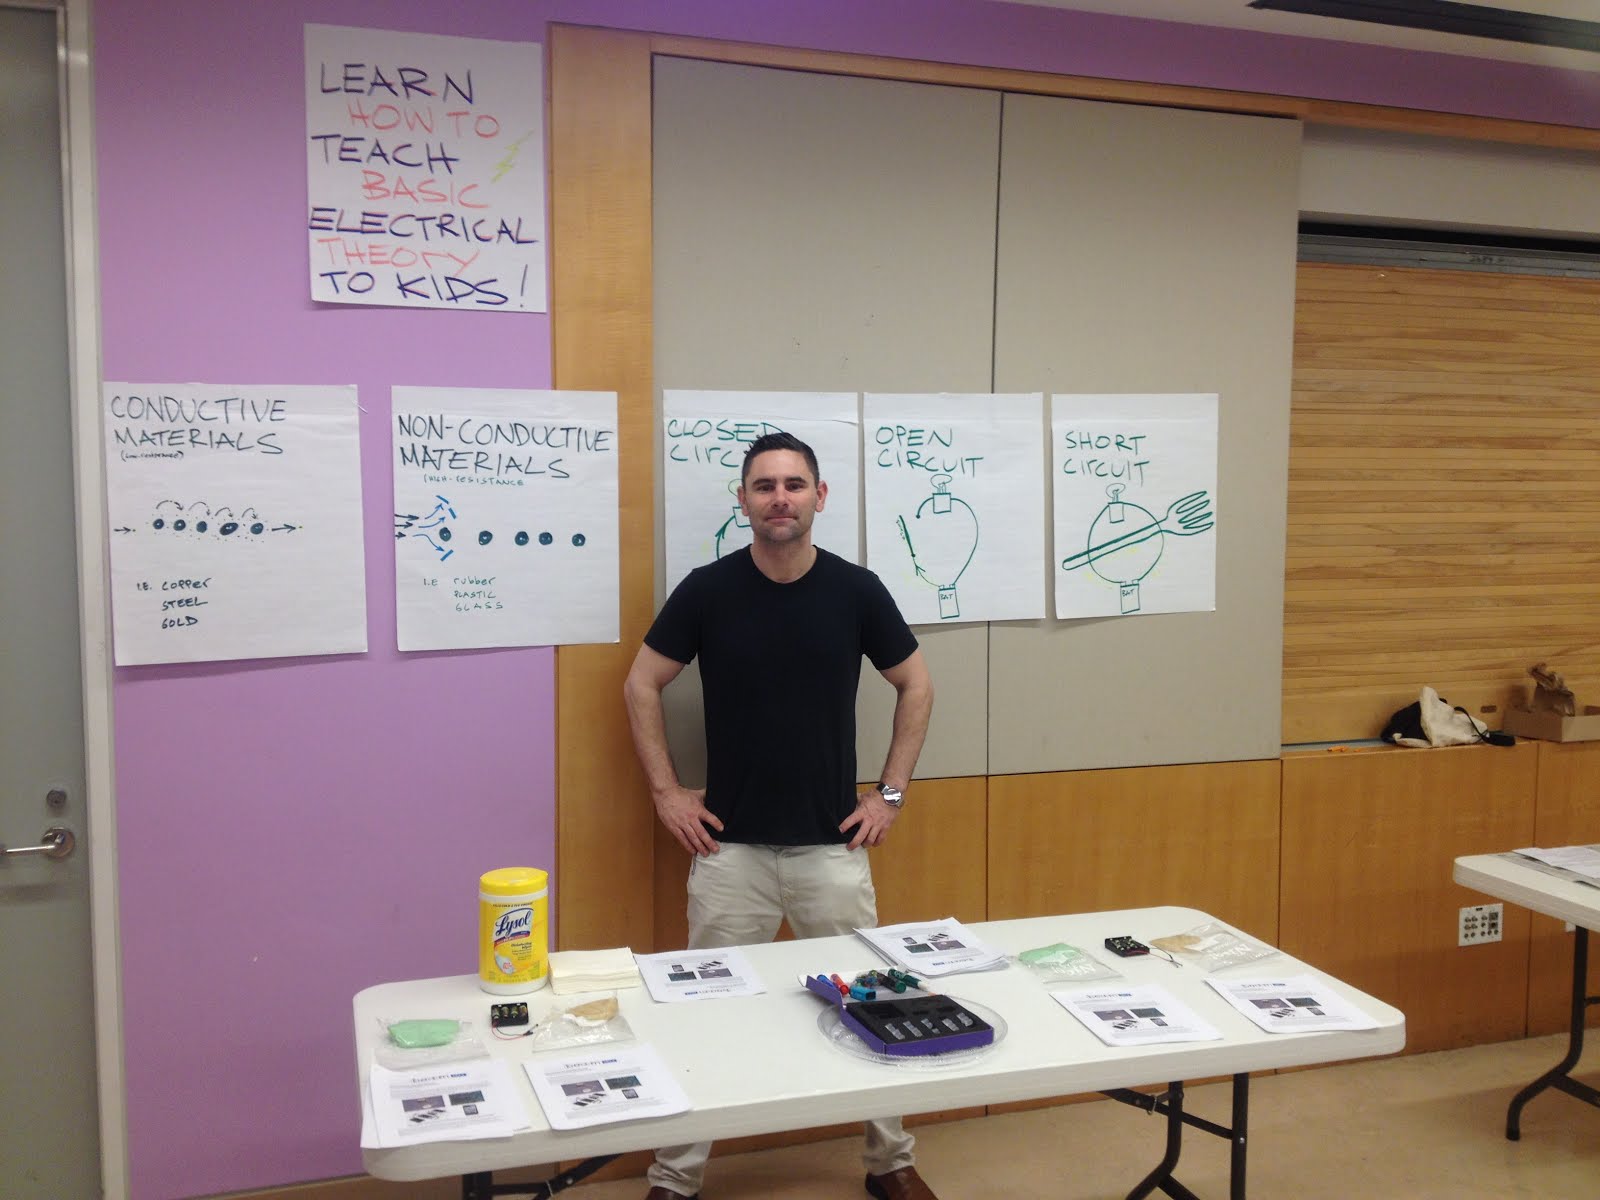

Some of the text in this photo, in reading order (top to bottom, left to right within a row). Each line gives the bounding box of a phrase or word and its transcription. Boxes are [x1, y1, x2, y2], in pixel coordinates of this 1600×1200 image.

[320, 62, 474, 104] LEARN
[347, 99, 500, 139] HOW TO
[311, 134, 460, 174] TEACH
[361, 169, 491, 209] BASIC
[309, 206, 539, 245] ELECTRICAL
[319, 271, 375, 294] TO
[111, 395, 287, 424] CONDUCTIVE
[114, 427, 284, 455] MATERIALS
[398, 413, 614, 453] NON-CONDUCTIVE
[875, 425, 953, 448] OPEN
[1064, 431, 1147, 455] SHORT
[400, 442, 570, 479] MATERIALS
[877, 448, 984, 478] CIRCUIT
[161, 597, 209, 612] STEEL
[161, 616, 198, 630] GOLD
[495, 910, 532, 938] Lysol
